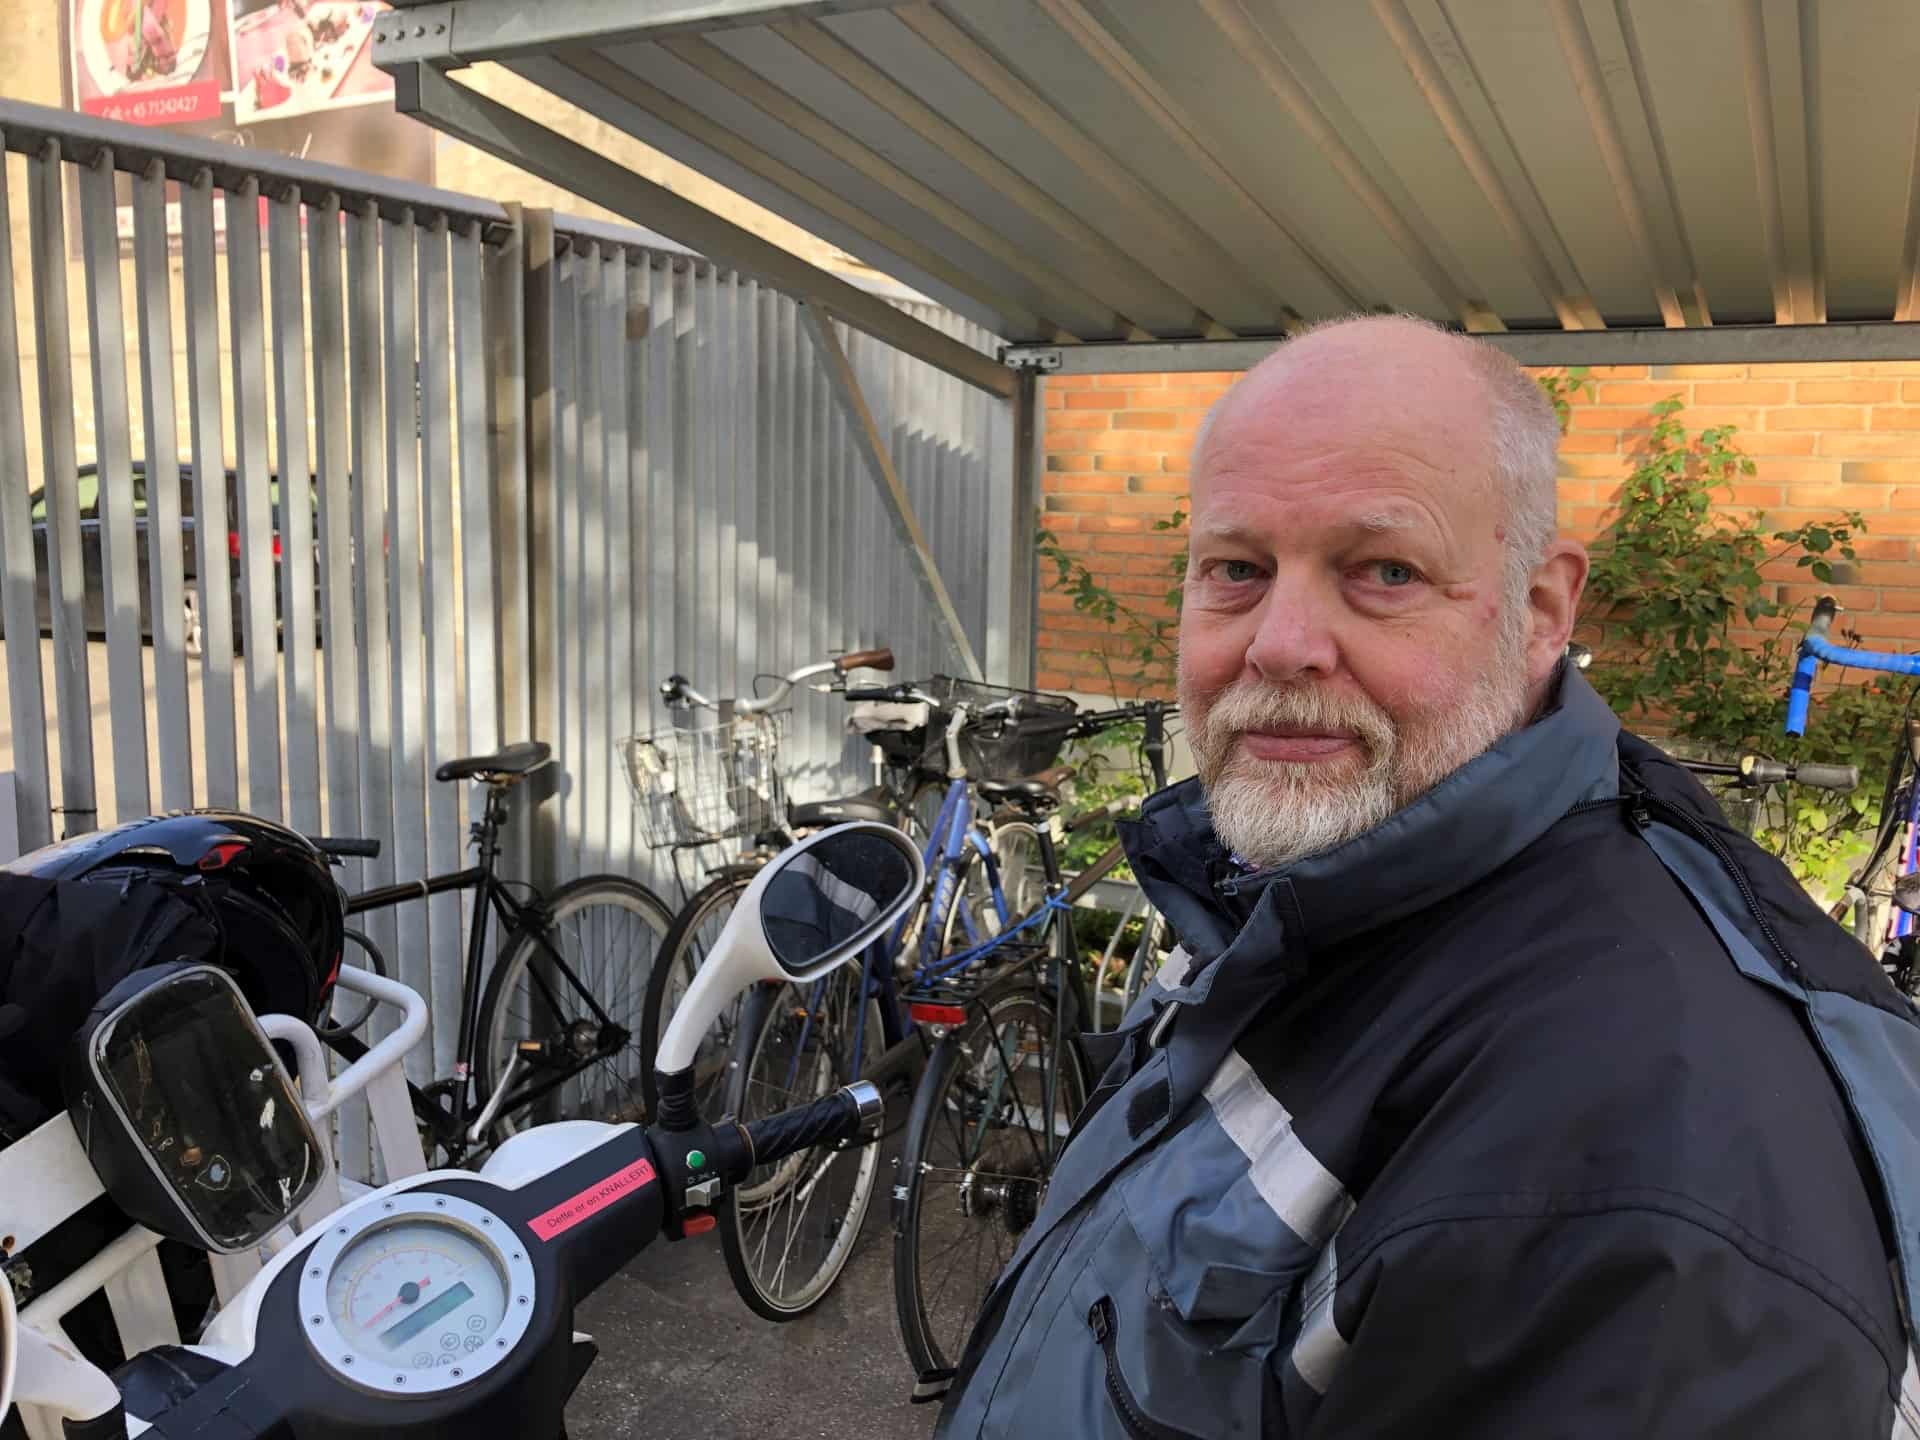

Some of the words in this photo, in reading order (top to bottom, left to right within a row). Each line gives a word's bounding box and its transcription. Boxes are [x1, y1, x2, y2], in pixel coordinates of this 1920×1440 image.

[546, 1210, 574, 1228] Dette
[575, 1203, 585, 1213] er
[587, 1195, 600, 1206] en
